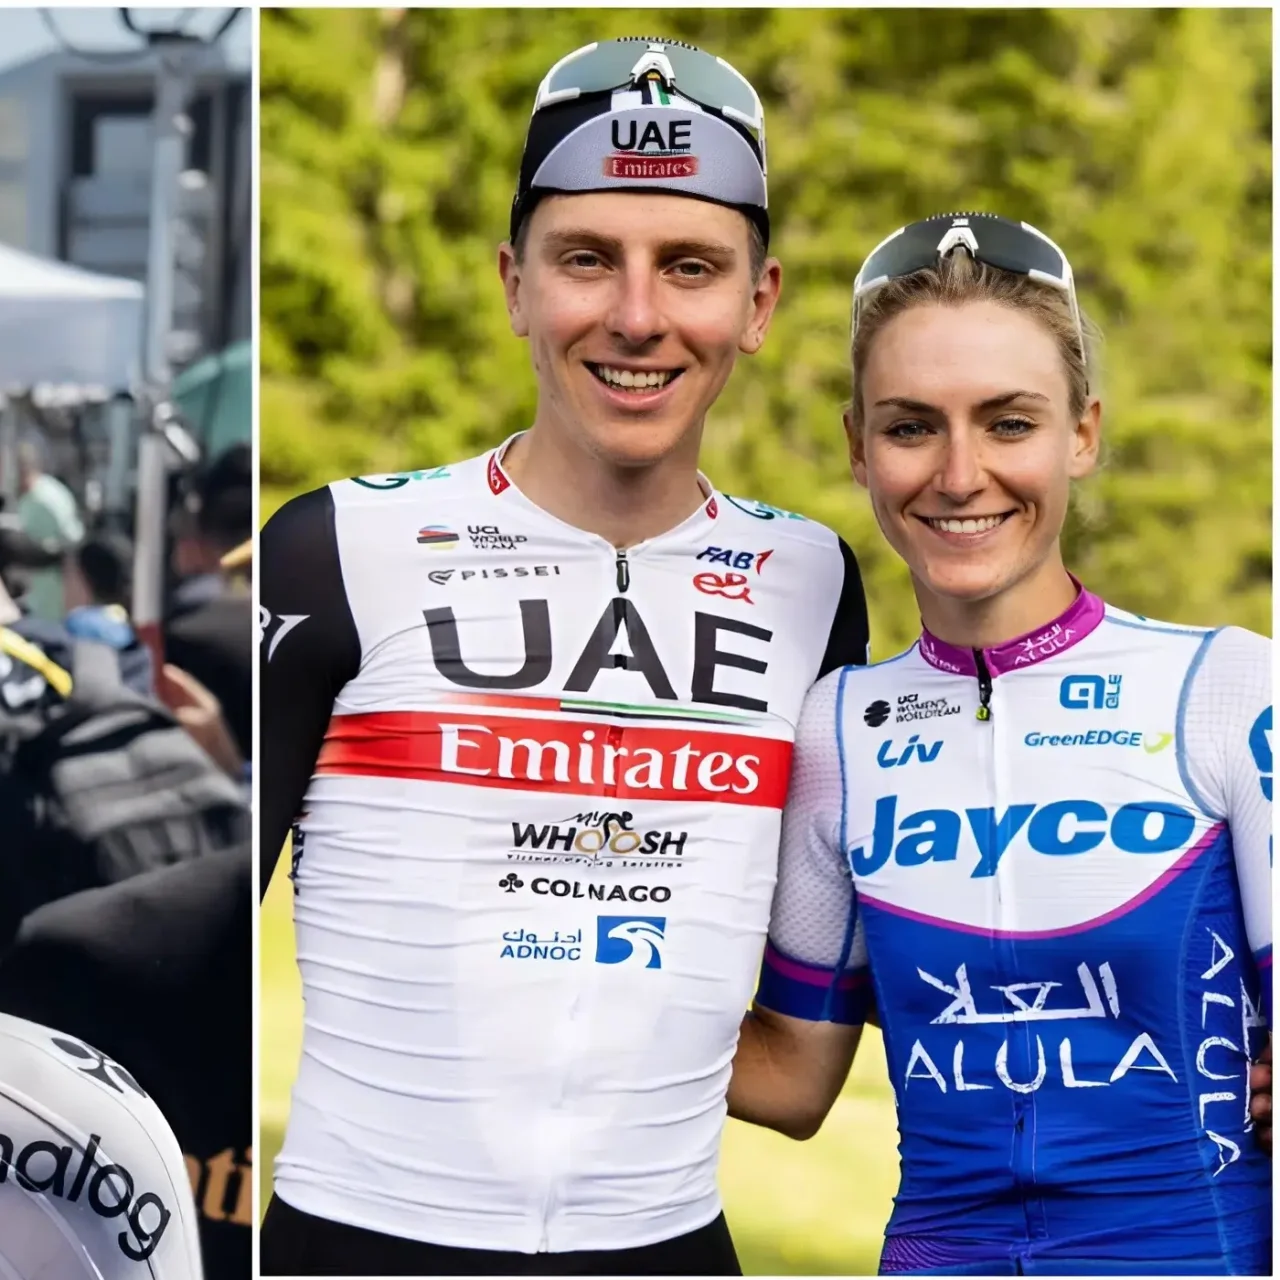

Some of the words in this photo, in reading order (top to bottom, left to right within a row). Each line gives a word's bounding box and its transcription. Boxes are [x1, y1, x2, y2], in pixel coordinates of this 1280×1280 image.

[611, 119, 692, 151] UAE
[612, 159, 692, 177] Emirates
[461, 564, 561, 582] PISSEI
[422, 596, 773, 713] UAE
[877, 734, 944, 768] Liv
[1024, 730, 1142, 747] GreenEDGE
[438, 722, 761, 796] Emirates
[511, 821, 688, 856] WHOOSH
[851, 794, 1196, 879] Jayco
[530, 877, 672, 903] COLNAGO
[500, 944, 581, 961] ADNOC
[904, 1032, 1179, 1093] ALULA
[1196, 926, 1241, 1178] ALULA
